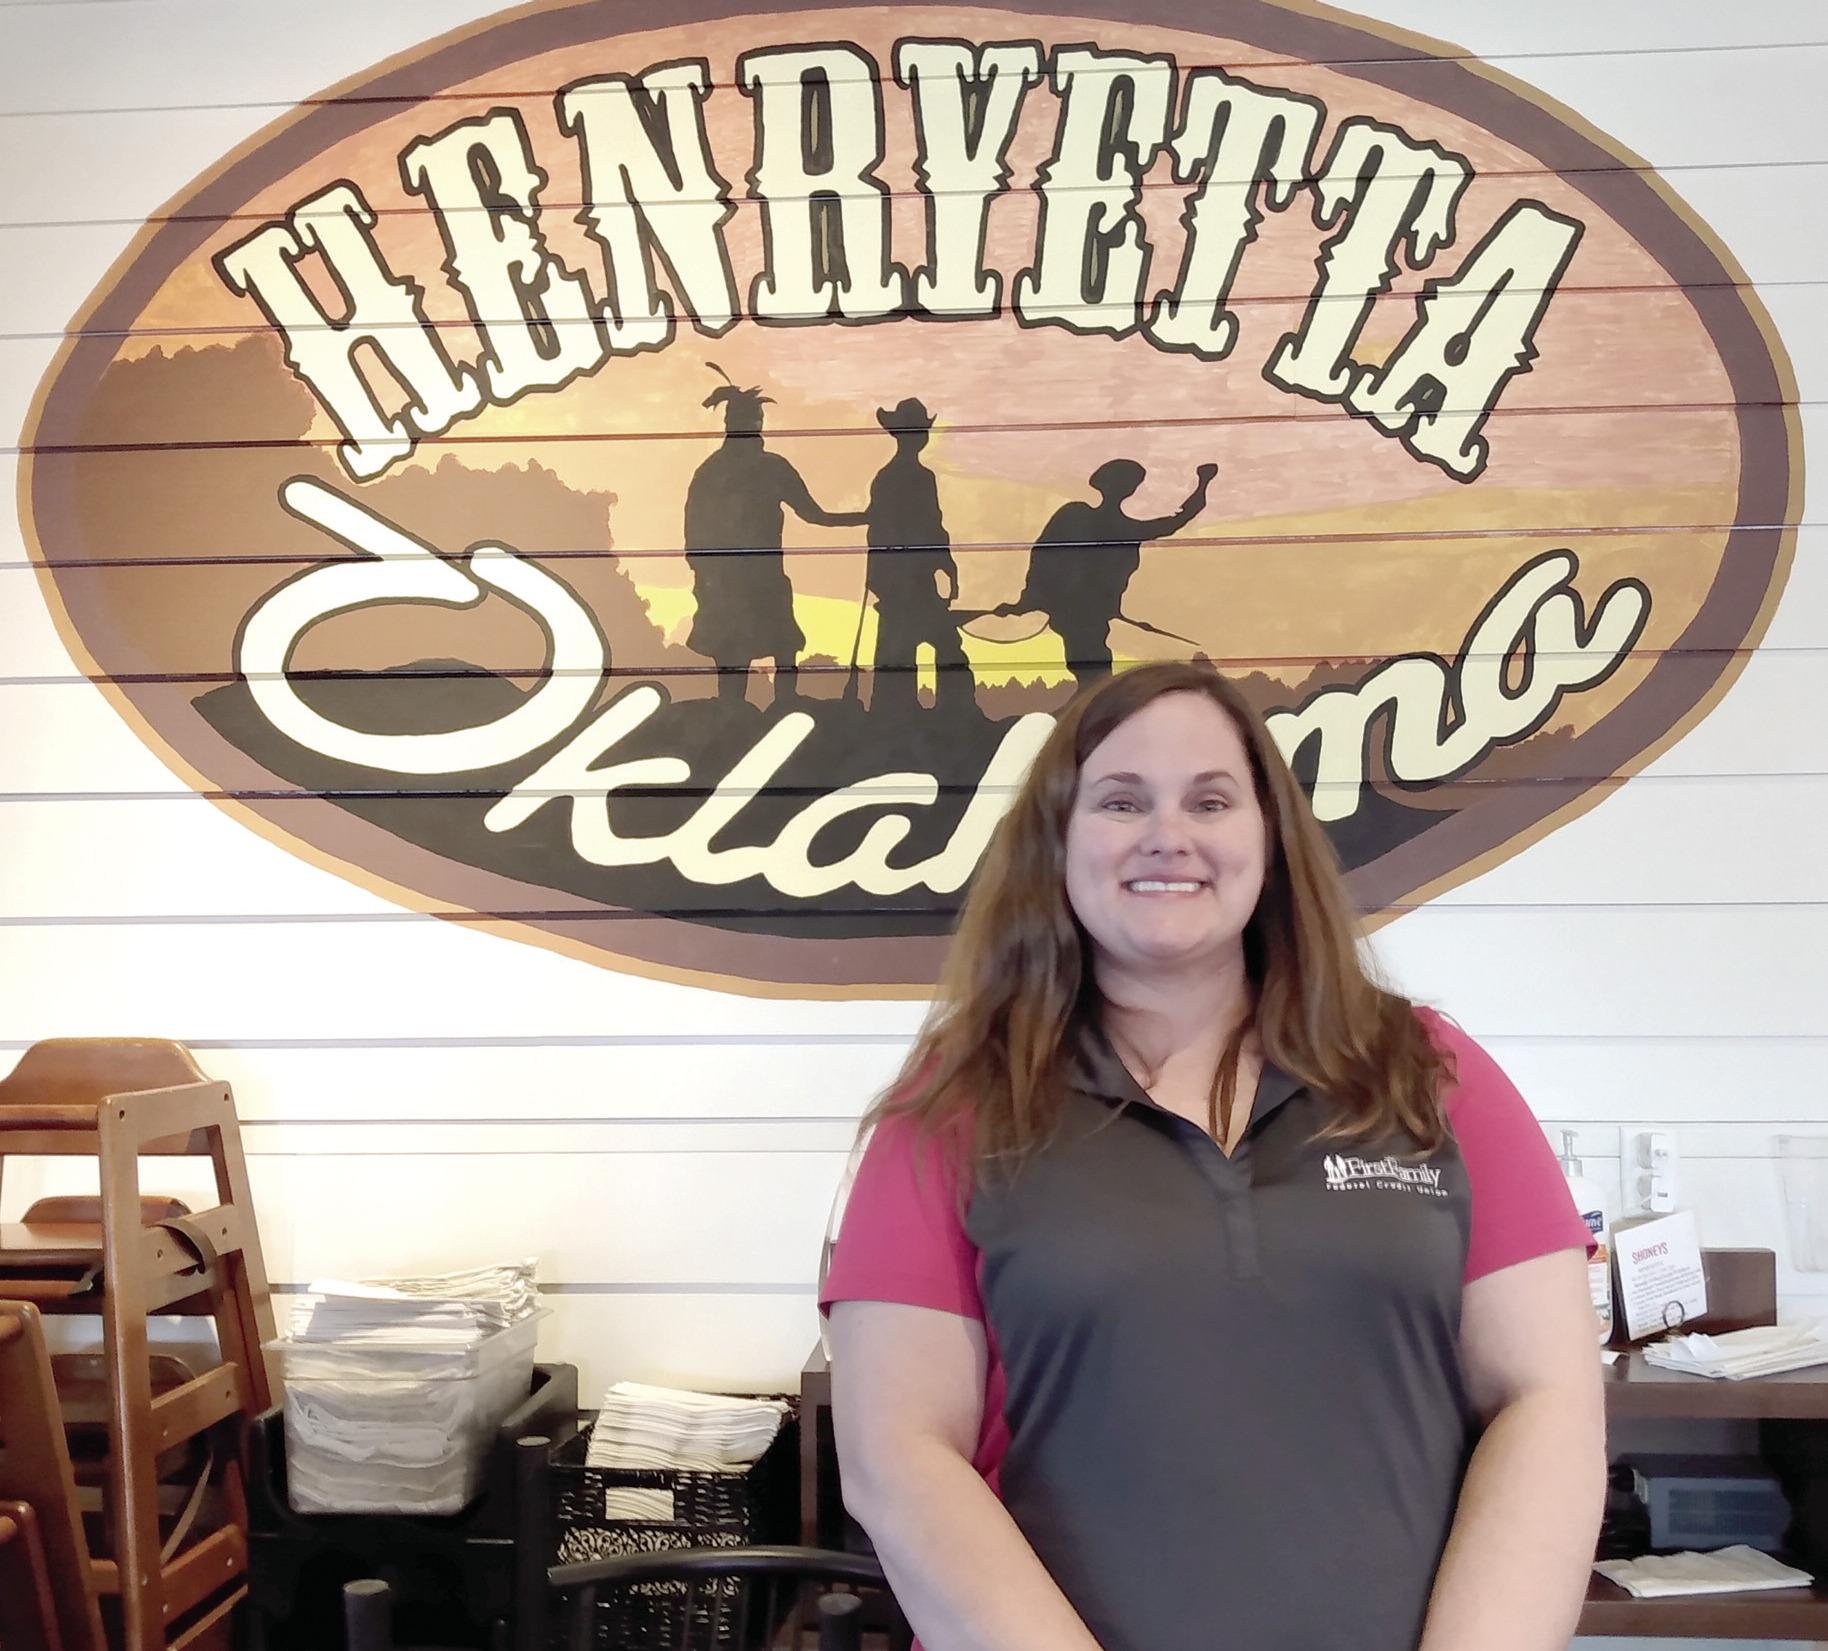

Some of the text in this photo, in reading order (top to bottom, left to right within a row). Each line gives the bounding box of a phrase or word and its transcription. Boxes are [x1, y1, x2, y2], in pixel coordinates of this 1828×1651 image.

[213, 39, 1584, 484] HENRYETTA
[233, 476, 1651, 898] Oklama
[1326, 1180, 1448, 1197] Federal Credit Union
